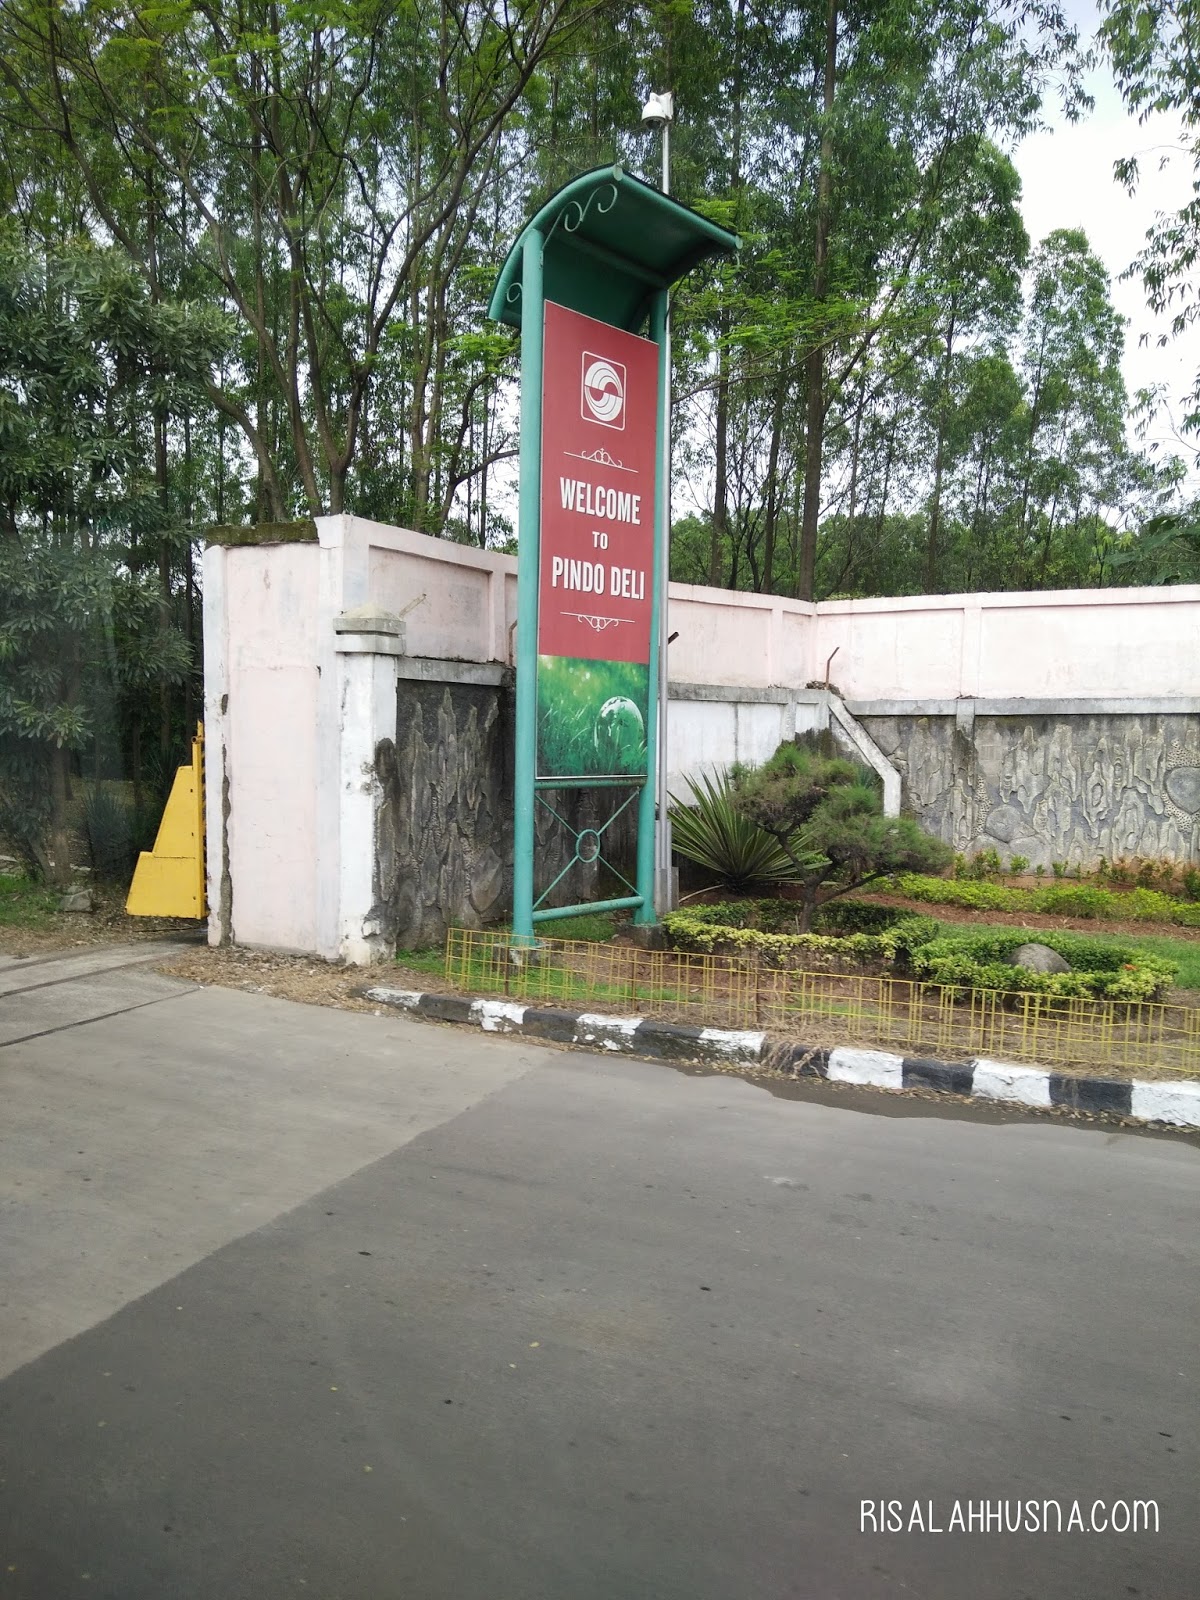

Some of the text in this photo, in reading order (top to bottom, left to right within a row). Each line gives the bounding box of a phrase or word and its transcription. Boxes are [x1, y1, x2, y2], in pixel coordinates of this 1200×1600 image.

[560, 477, 641, 525] WELCOME
[592, 531, 609, 550] TO
[552, 556, 645, 600] PINDO DELI
